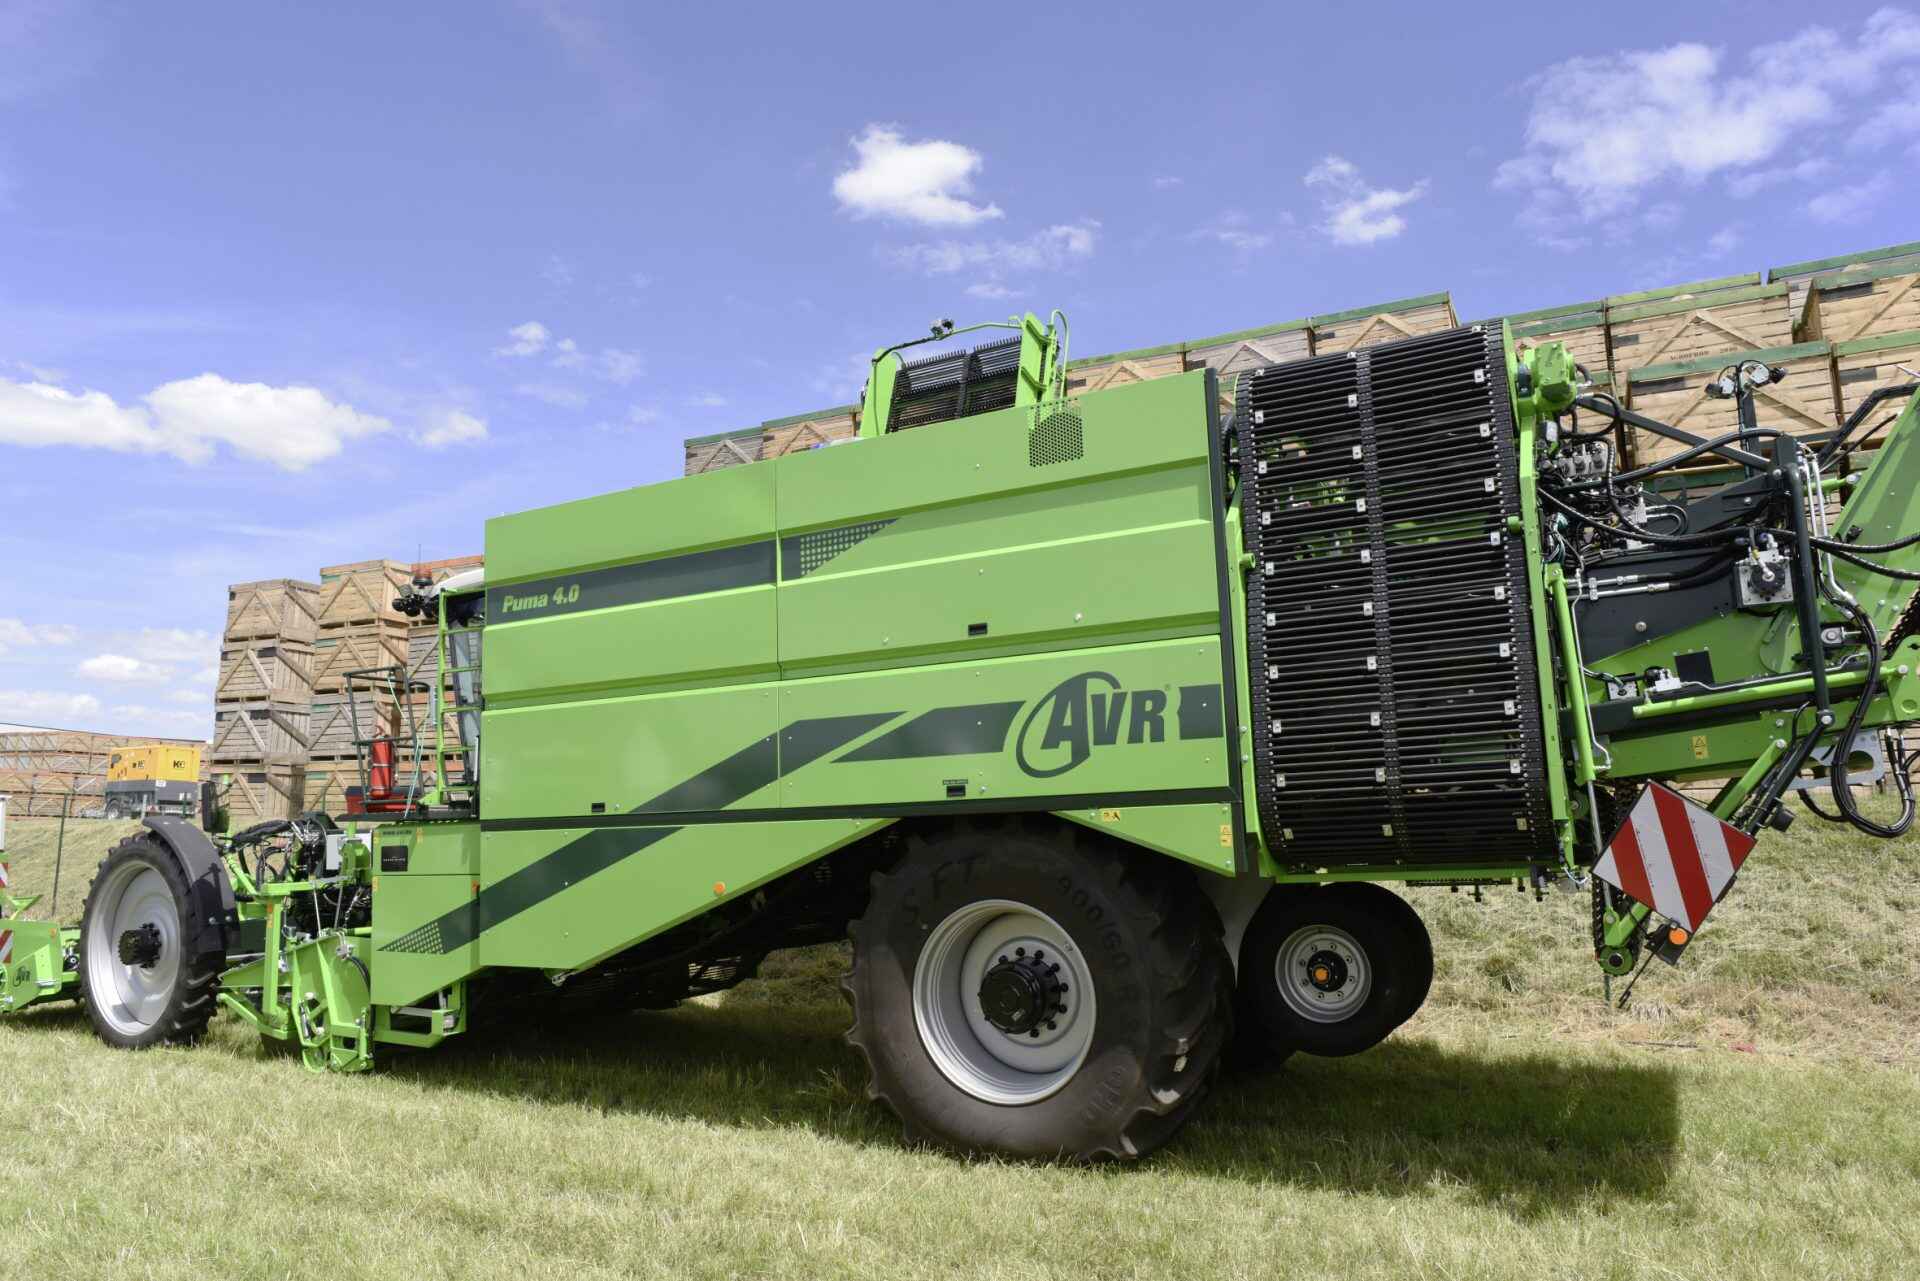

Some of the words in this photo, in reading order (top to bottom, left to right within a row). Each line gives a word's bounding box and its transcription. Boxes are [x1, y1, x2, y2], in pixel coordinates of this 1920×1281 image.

[502, 593, 549, 613] Puma
[552, 584, 580, 605] 4.0
[1016, 671, 1167, 778] AVR
